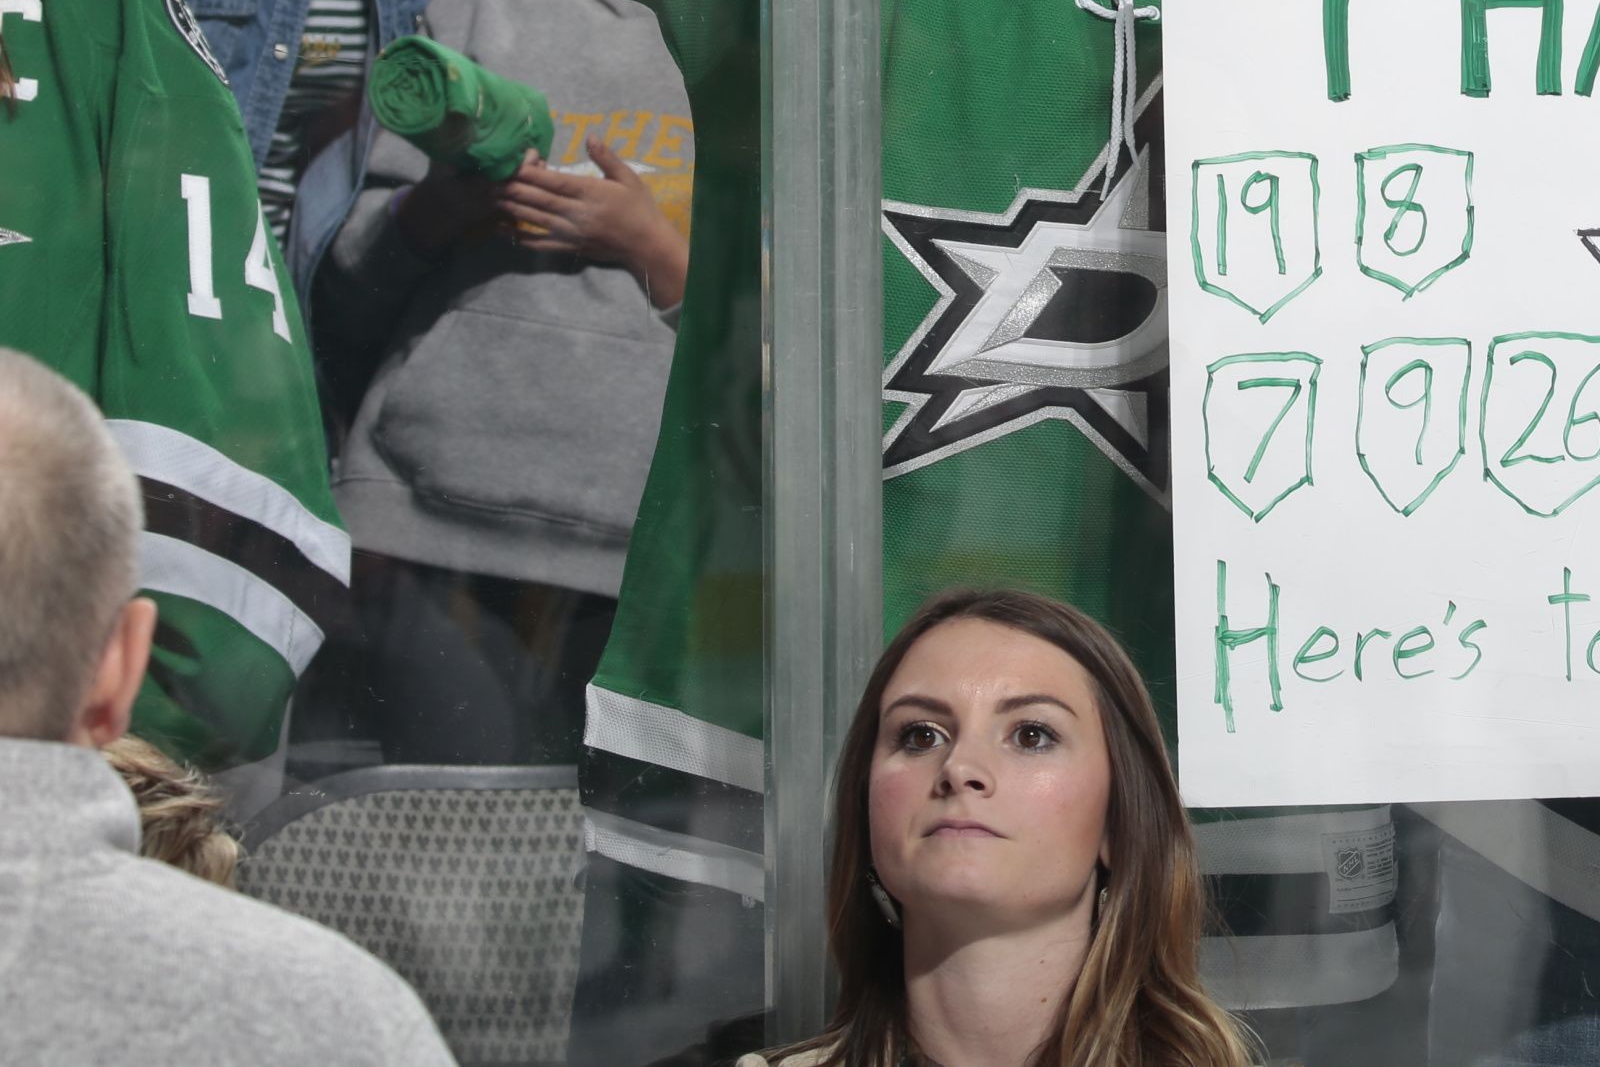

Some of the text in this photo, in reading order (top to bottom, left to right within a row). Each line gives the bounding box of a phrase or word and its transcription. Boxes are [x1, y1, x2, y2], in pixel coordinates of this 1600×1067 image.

[180, 173, 293, 344] 14
[1216, 170, 1287, 276] 19
[1380, 163, 1428, 256] 8
[1237, 377, 1302, 483] 7
[1385, 359, 1434, 465] 9
[1213, 559, 1488, 733] Here's
